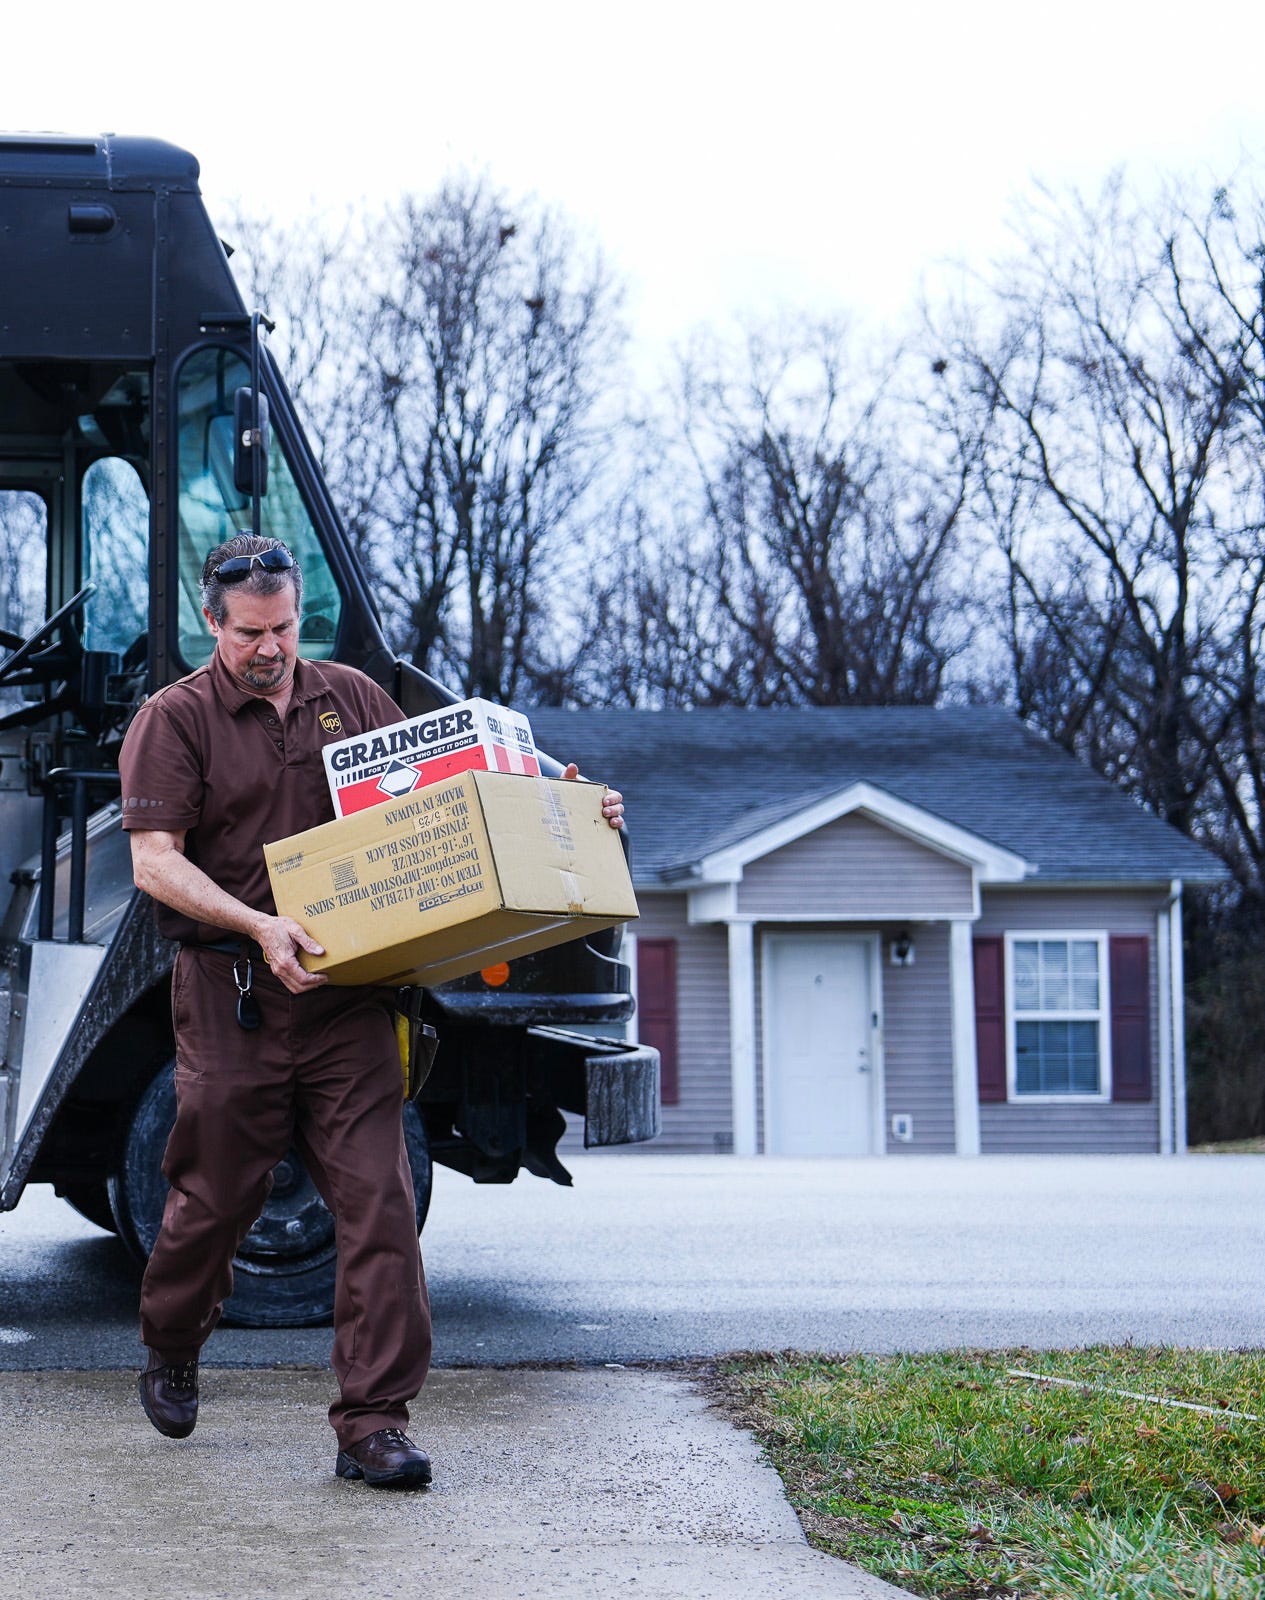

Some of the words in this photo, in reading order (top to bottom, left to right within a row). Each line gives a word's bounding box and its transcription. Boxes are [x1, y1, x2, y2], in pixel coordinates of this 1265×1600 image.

[322, 718, 340, 730] ups
[487, 715, 531, 744] GRAGER
[330, 709, 474, 772] GRAINGER
[368, 766, 382, 775] FOR
[401, 755, 415, 764] NES
[416, 751, 432, 760] WHO
[432, 747, 447, 755] GET
[454, 737, 475, 749] DONE
[422, 797, 435, 810] IN
[435, 785, 465, 806] MADE
[384, 801, 423, 826] TAIWAN
[418, 811, 441, 829] 5/25
[399, 830, 432, 852] GLOSS
[365, 841, 398, 864] BLACK
[456, 863, 482, 882] ITEM
[335, 885, 370, 907] WHEEL
[370, 886, 415, 912] 412BLKN
